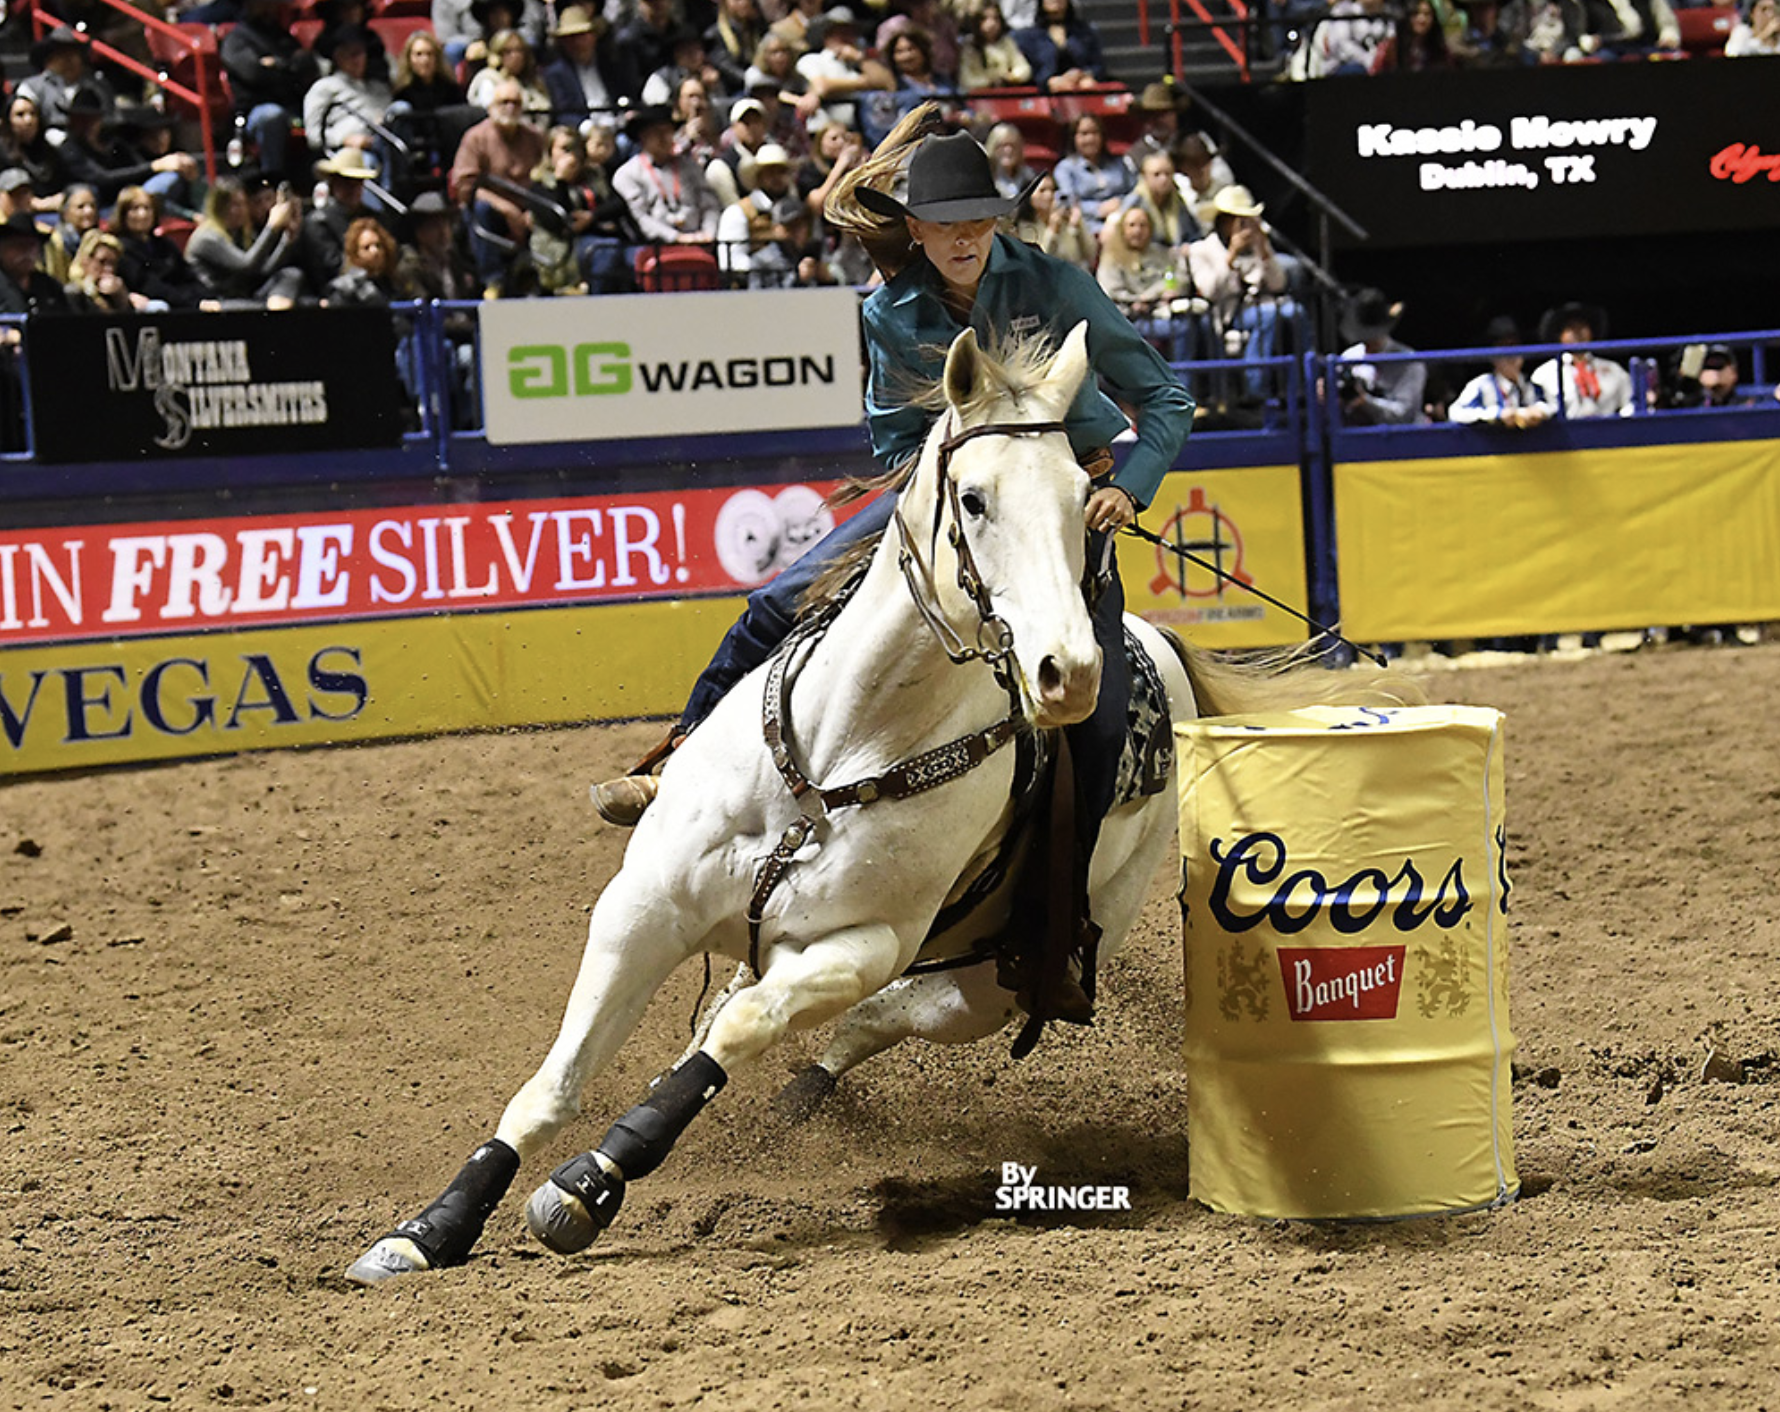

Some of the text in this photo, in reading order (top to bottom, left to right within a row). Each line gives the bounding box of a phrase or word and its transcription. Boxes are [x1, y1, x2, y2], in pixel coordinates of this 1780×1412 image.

[1510, 115, 1657, 150] Mowry
[1419, 154, 1597, 190] Dublin, TX
[639, 354, 834, 393] WAGON
[101, 523, 354, 623] FREE
[368, 502, 691, 603] SILVER!
[0, 645, 369, 752] VEGAS
[1208, 831, 1474, 935] Coors
[1293, 953, 1397, 1014] Banquet
